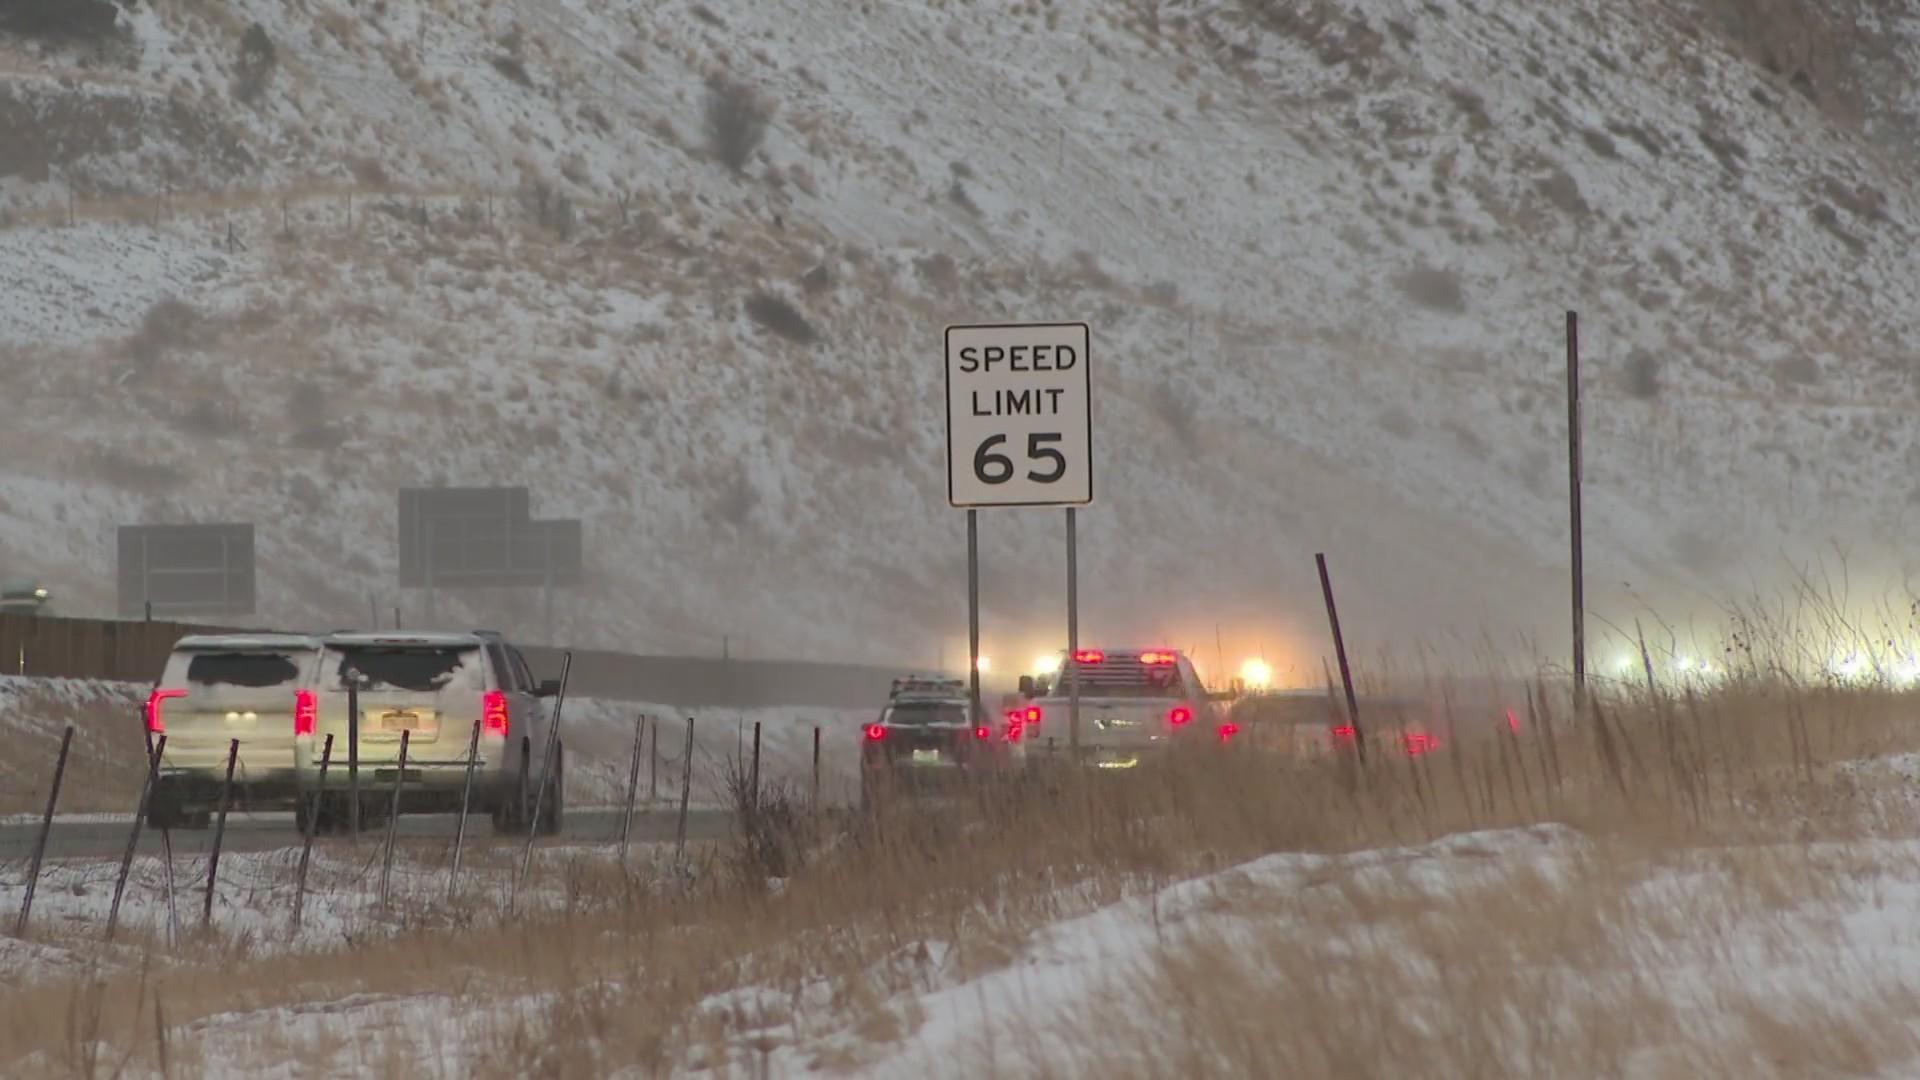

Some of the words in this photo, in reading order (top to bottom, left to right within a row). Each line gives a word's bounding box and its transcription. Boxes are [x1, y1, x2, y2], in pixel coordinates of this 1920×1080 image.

[959, 344, 1076, 373] SPEED
[972, 388, 1064, 416] LIMIT
[973, 432, 1067, 485] 65
